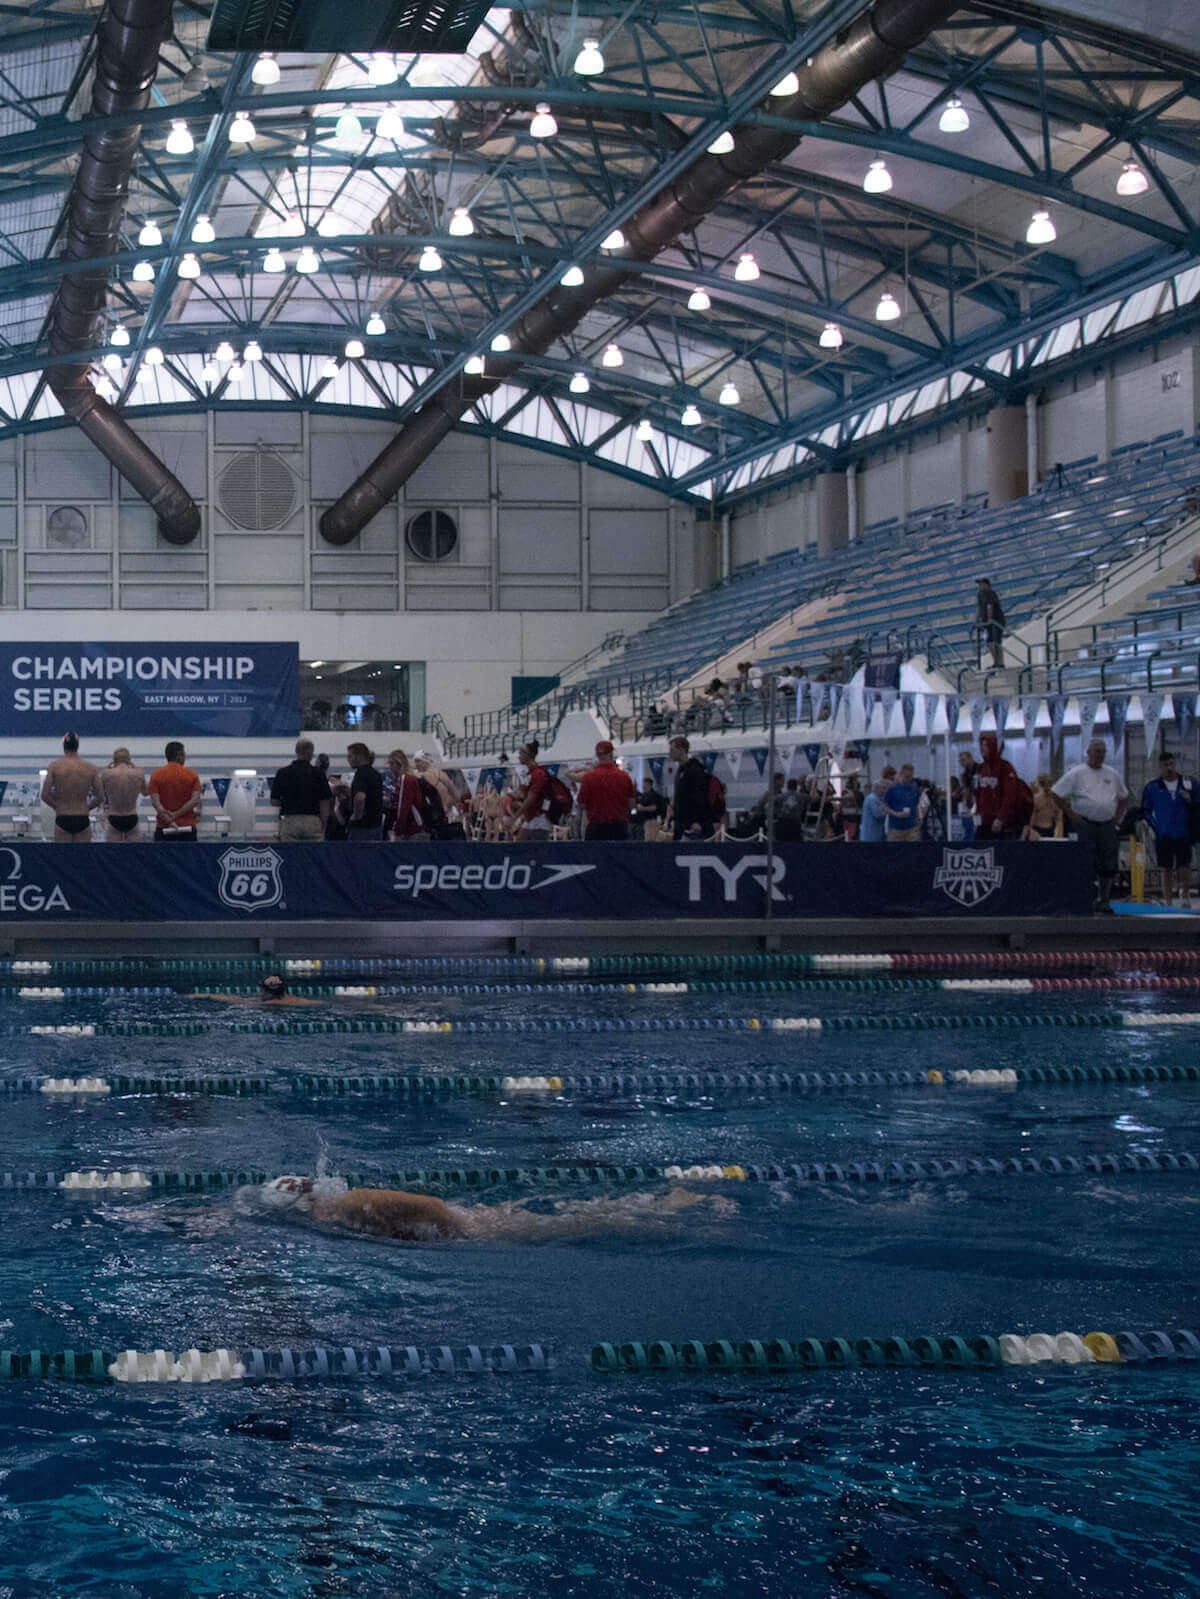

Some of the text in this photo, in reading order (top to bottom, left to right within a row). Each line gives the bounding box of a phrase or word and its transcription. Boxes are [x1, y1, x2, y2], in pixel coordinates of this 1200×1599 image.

[11, 656, 255, 680] CHAMPIONSHIP
[13, 687, 122, 712] SERIES
[144, 695, 164, 704] EAST
[166, 695, 206, 705] MEADOW,
[207, 695, 220, 704] NY
[228, 856, 273, 868] PHILLIPS
[950, 854, 987, 871] USA
[231, 873, 270, 897] 66
[393, 856, 532, 898] speedo
[675, 855, 788, 902] TYR
